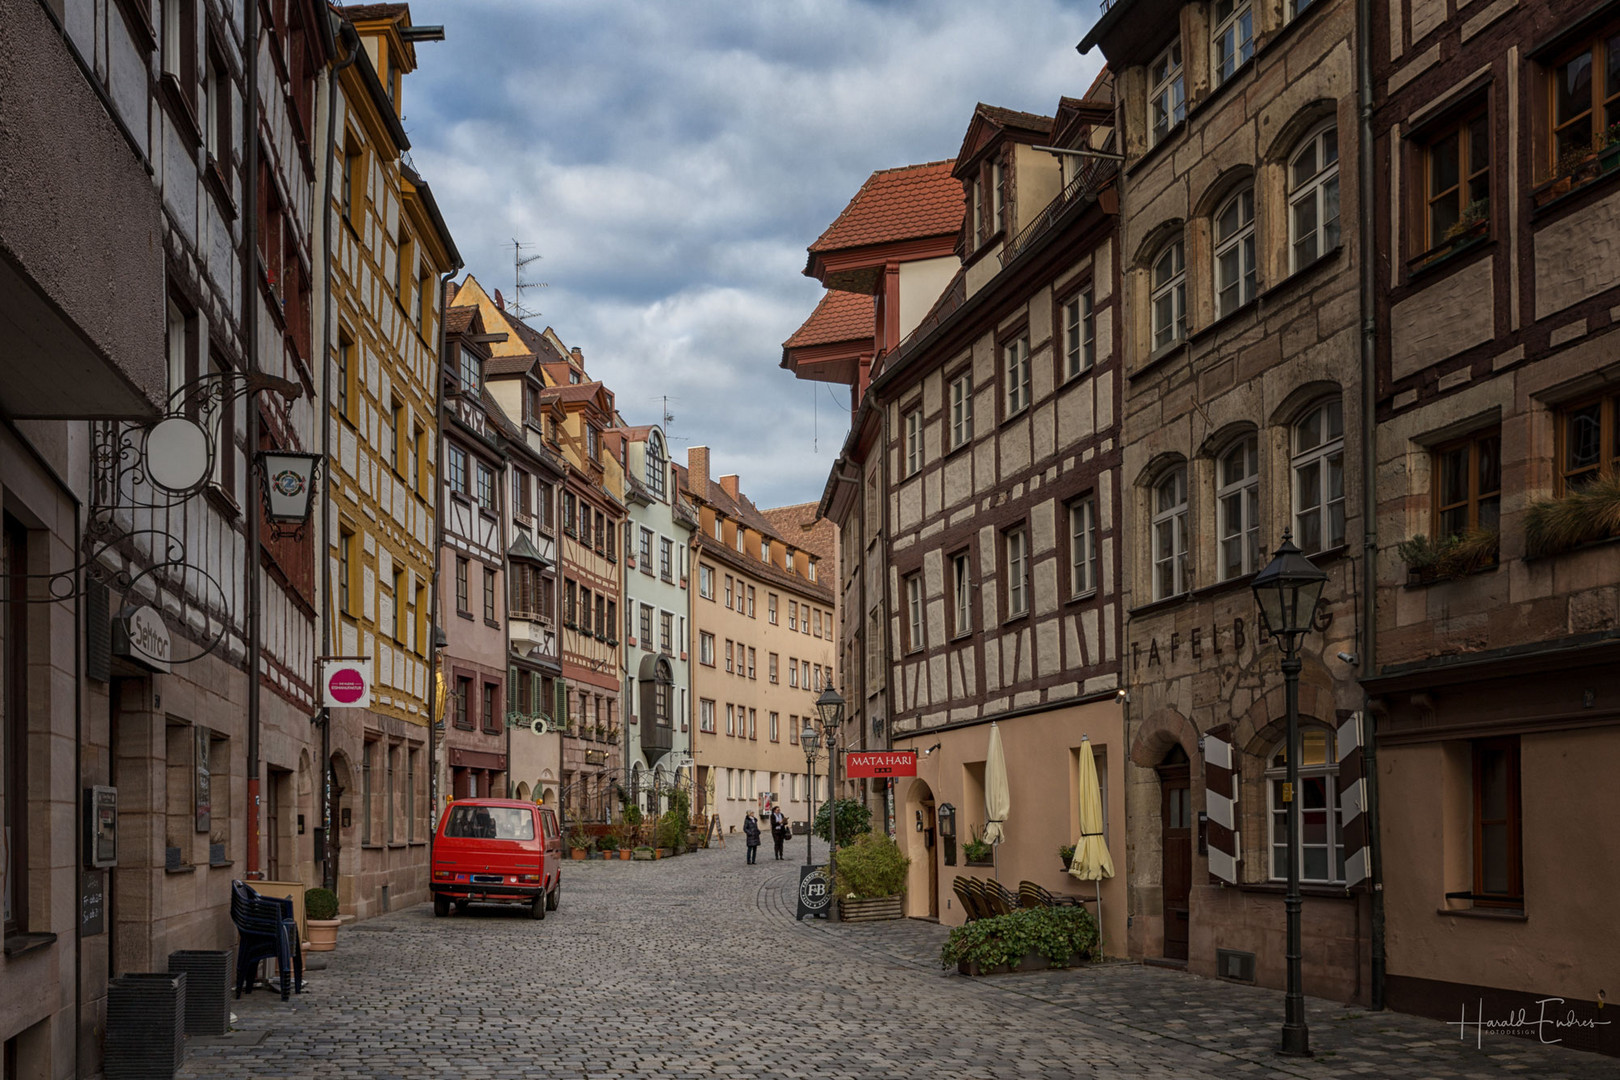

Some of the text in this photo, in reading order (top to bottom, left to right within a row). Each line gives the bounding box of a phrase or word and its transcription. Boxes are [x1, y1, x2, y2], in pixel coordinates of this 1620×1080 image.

[135, 615, 169, 659] Sektor
[1131, 597, 1334, 671] TAFELBEG
[851, 755, 912, 767] MATA HARI
